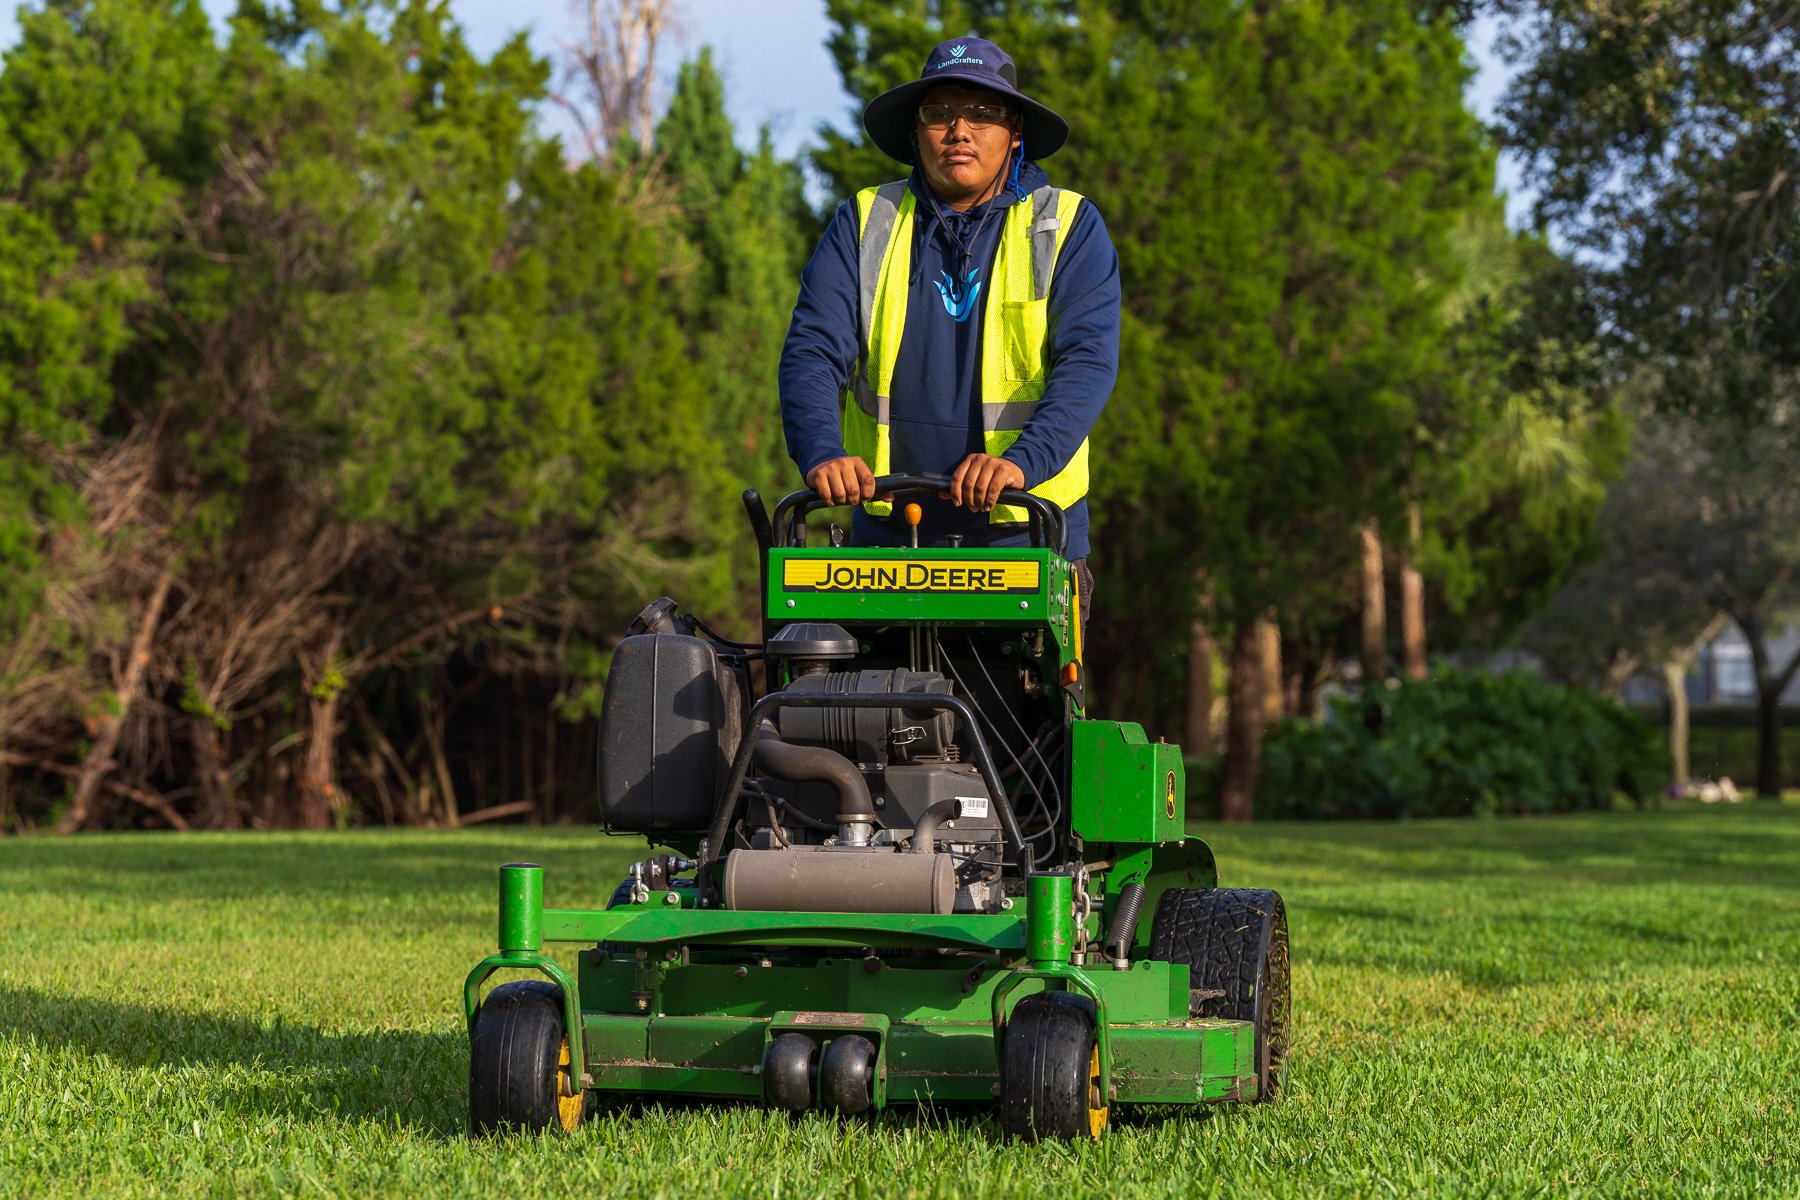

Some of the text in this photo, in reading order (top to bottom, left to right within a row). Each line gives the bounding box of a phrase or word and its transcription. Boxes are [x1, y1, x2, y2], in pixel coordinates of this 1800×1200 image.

[937, 57, 984, 69] LandCrafters
[815, 563, 1006, 588] JOHN DEERE
